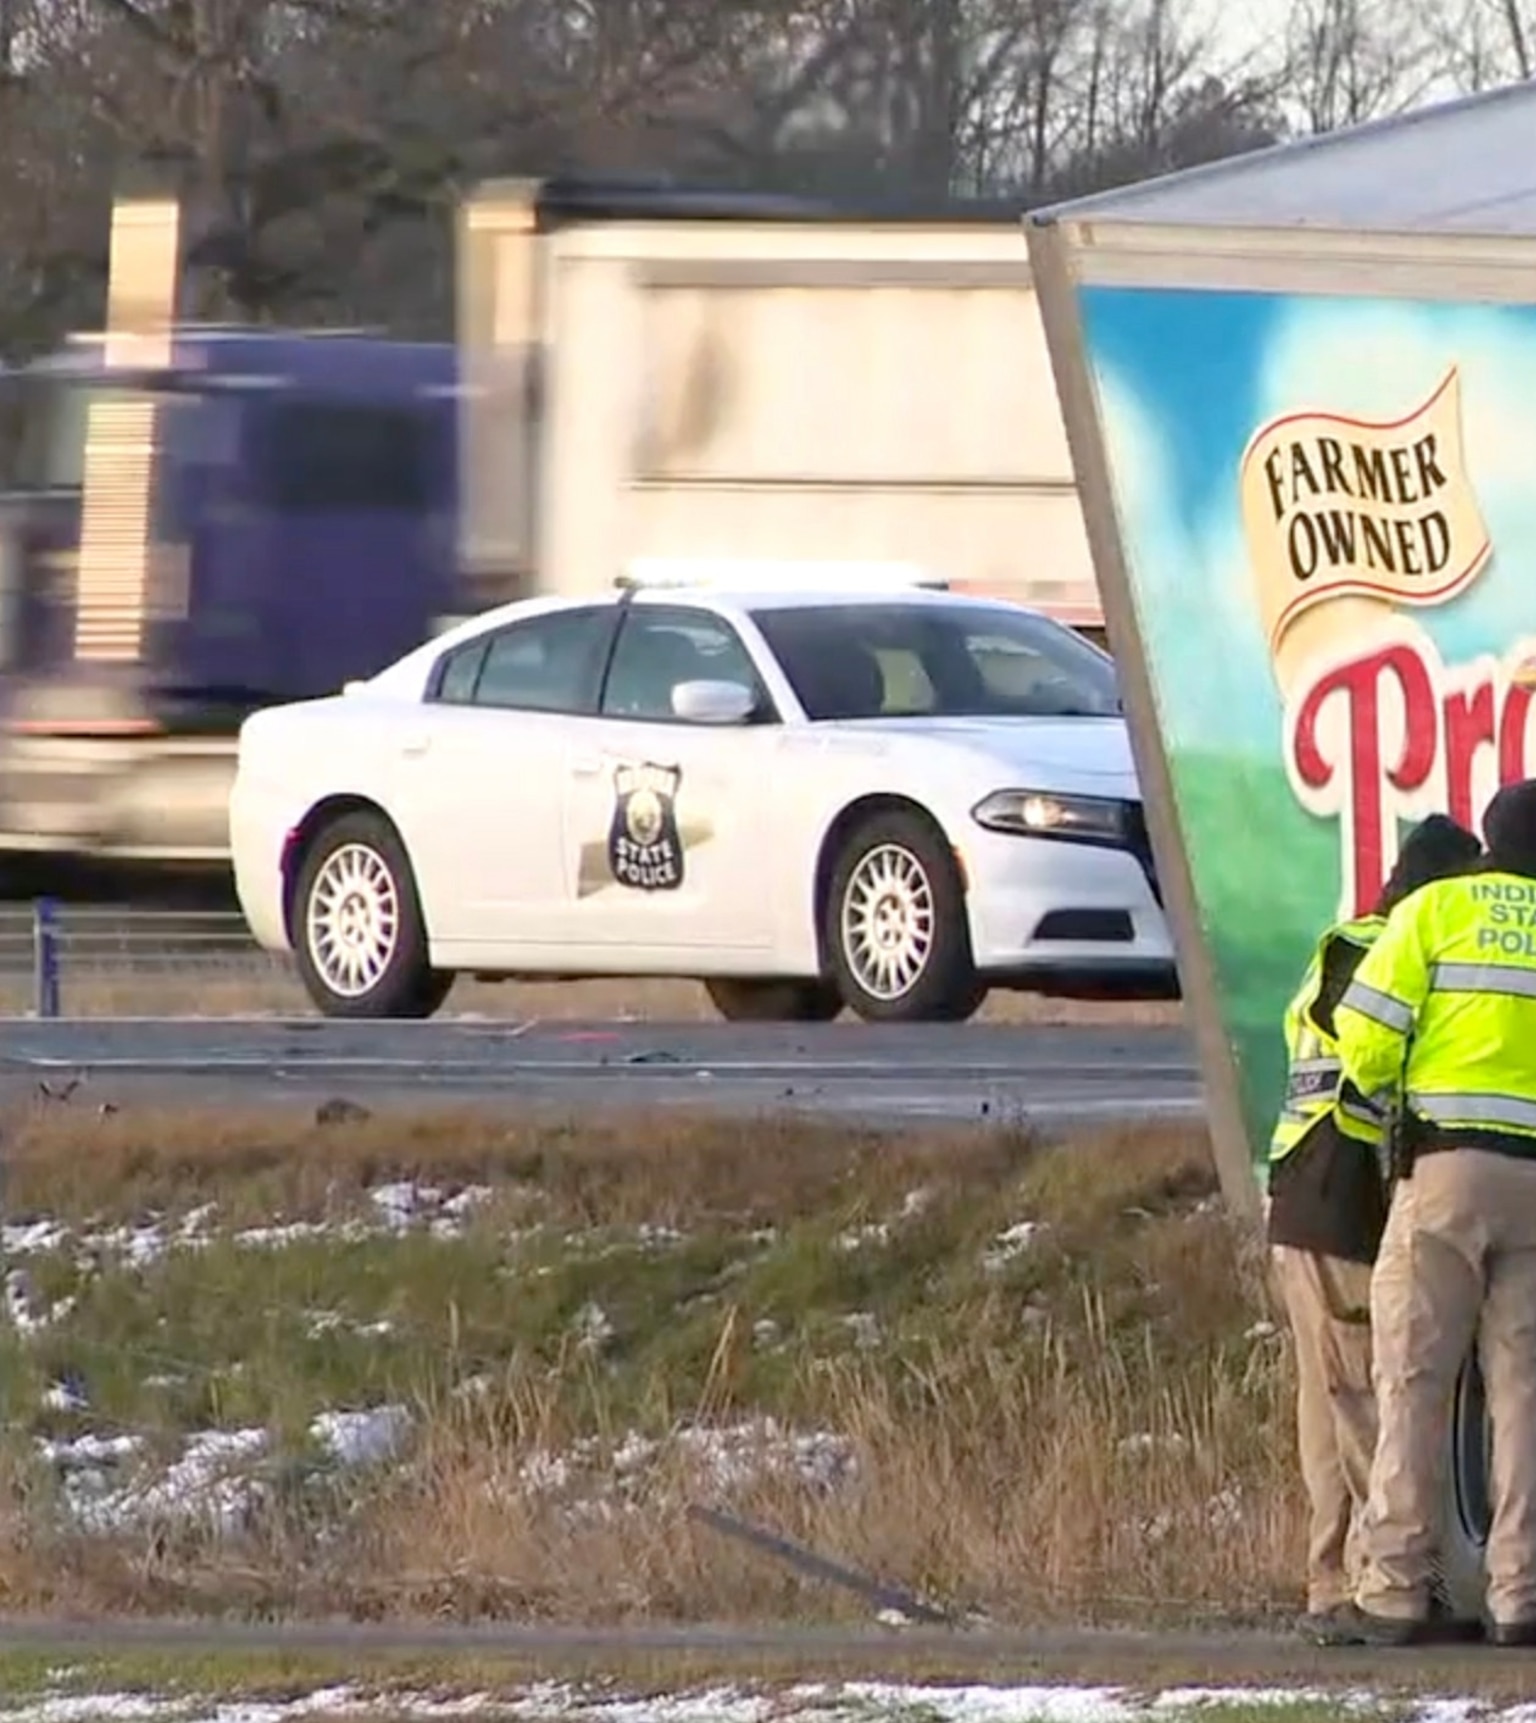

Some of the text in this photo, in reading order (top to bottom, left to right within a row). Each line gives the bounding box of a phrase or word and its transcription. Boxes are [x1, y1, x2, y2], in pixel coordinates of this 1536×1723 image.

[1264, 433, 1447, 523] FARMER
[1288, 510, 1450, 581] OWNED
[616, 837, 673, 864] STATE
[618, 857, 677, 885] POLICE
